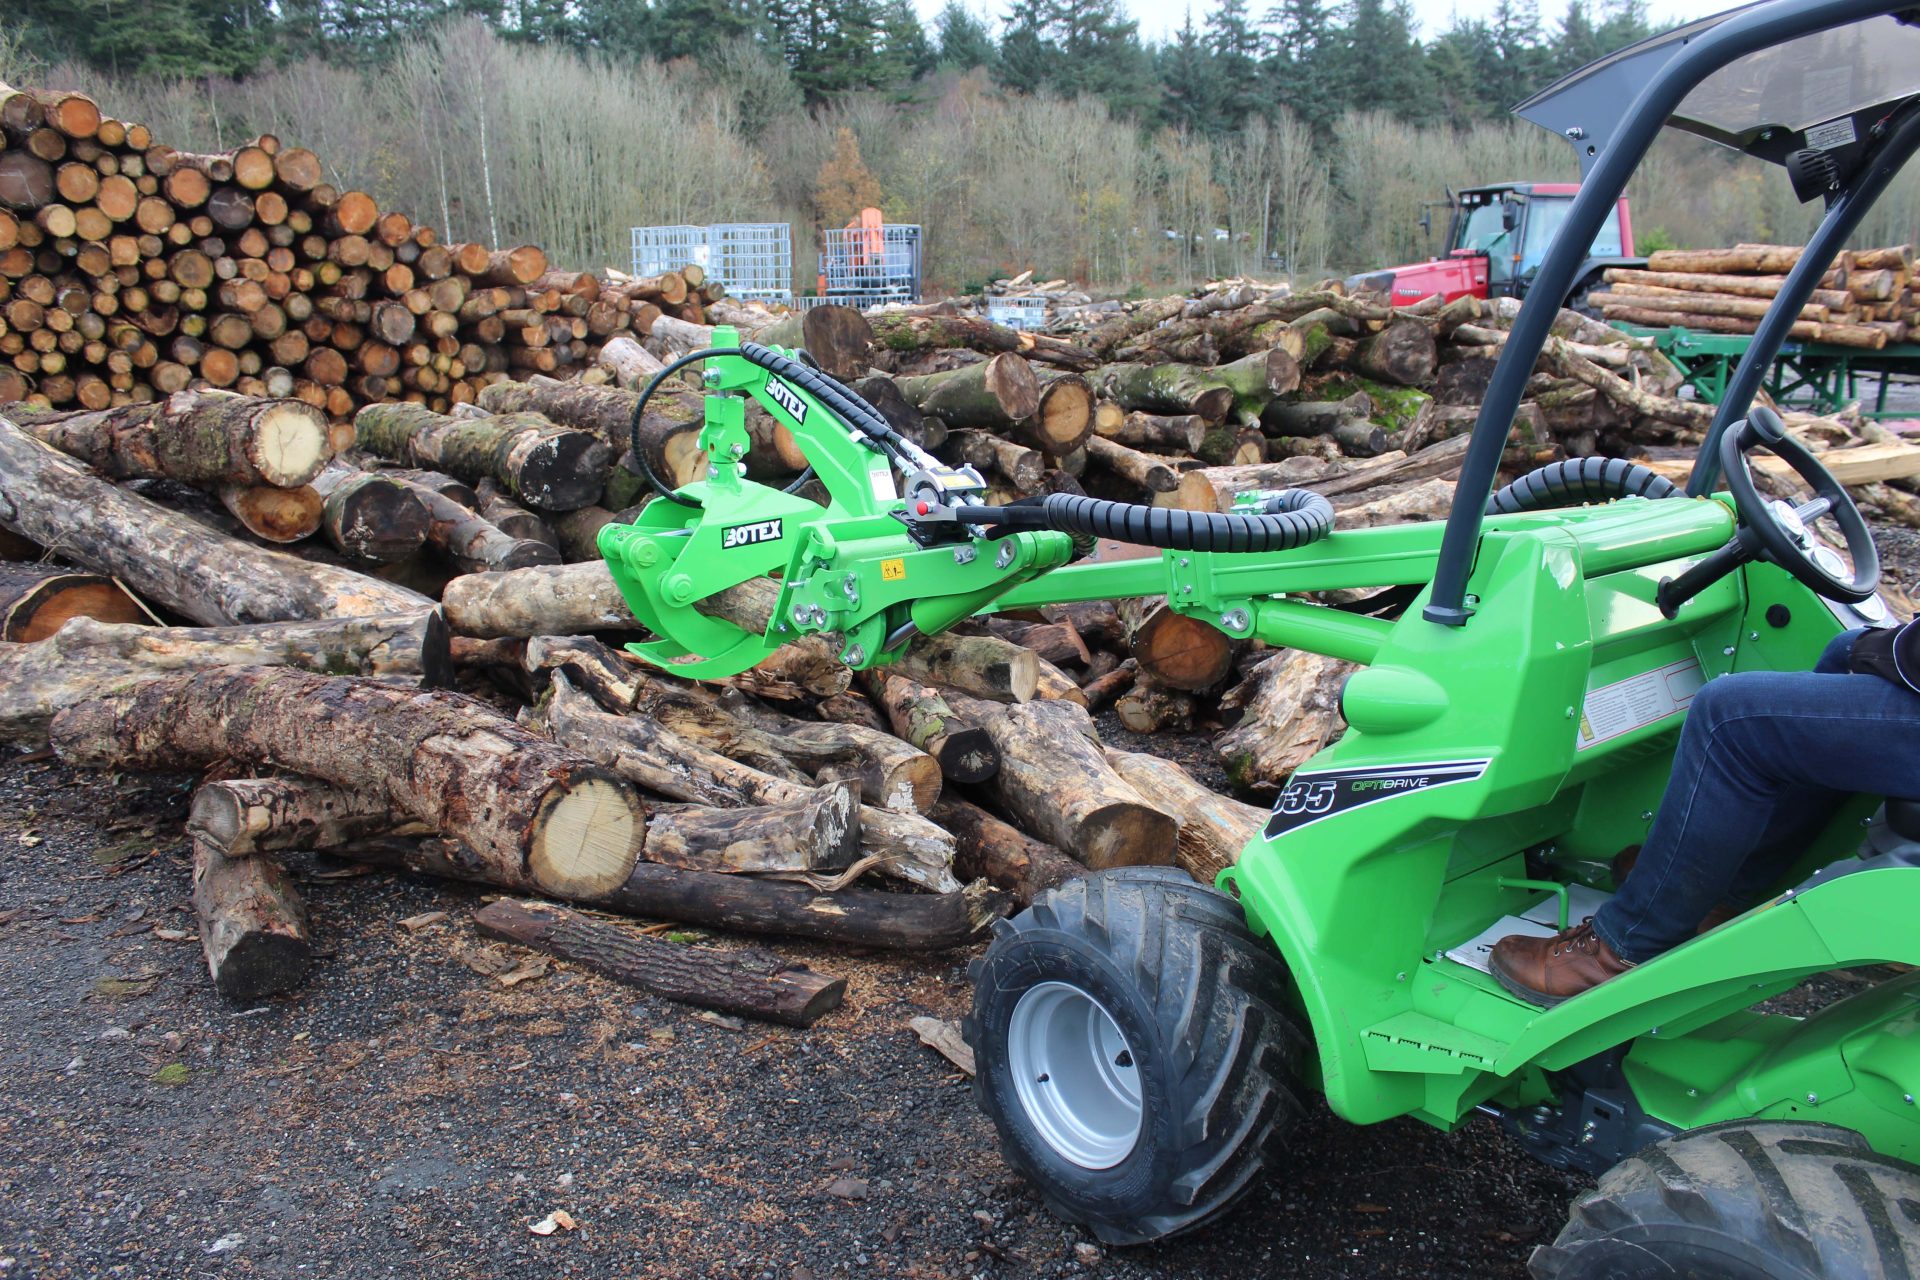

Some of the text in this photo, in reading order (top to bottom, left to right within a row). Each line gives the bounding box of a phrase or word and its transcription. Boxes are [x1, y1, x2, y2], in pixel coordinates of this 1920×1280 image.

[765, 377, 807, 424] BOTEX
[723, 519, 782, 548] BOTEX
[1351, 777, 1430, 792] OPTIDRIVE
